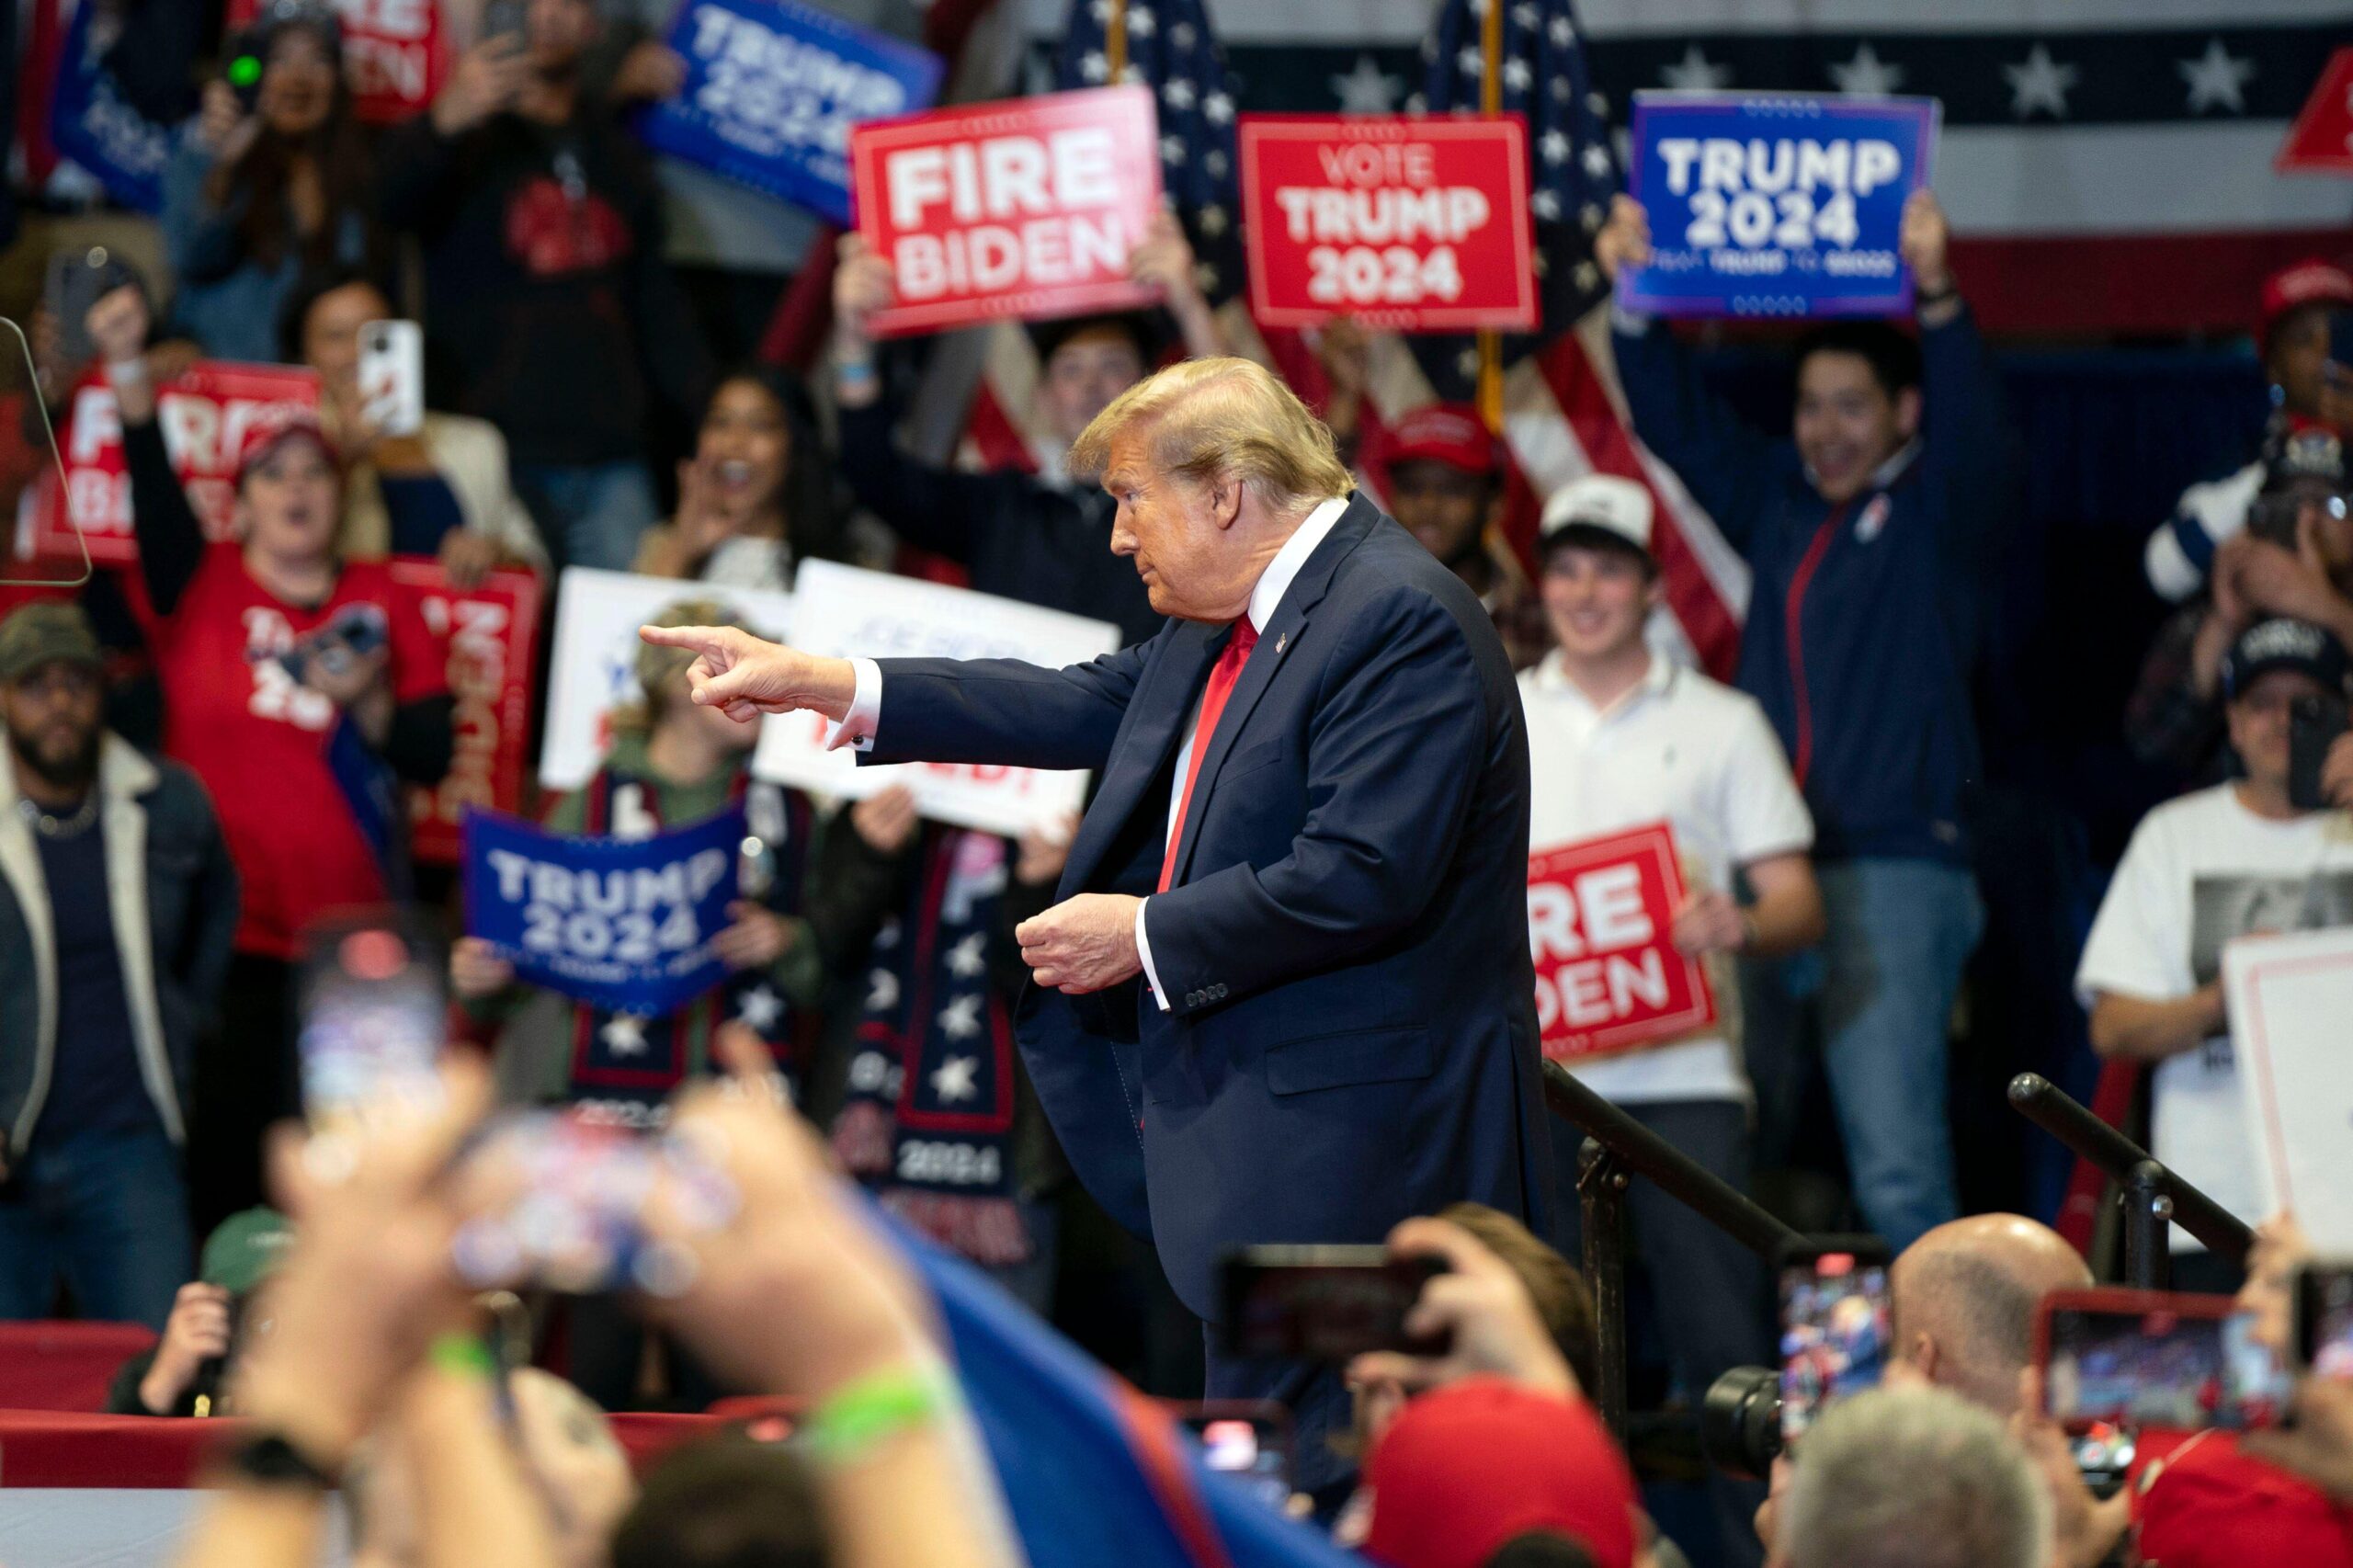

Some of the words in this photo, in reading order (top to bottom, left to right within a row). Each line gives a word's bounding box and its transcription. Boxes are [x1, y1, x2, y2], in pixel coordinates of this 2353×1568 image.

[884, 127, 1120, 229] FIRE
[1317, 143, 1437, 184] VOTE
[1656, 137, 1903, 197] TRUMP
[1275, 186, 1490, 244] TRUMP
[1685, 189, 1860, 248] 2024
[894, 214, 1126, 301] BIDEN
[1307, 244, 1464, 304] 2024
[486, 847, 727, 915] TRUMP
[521, 899, 699, 961] 2024
[1527, 861, 1654, 968] RE
